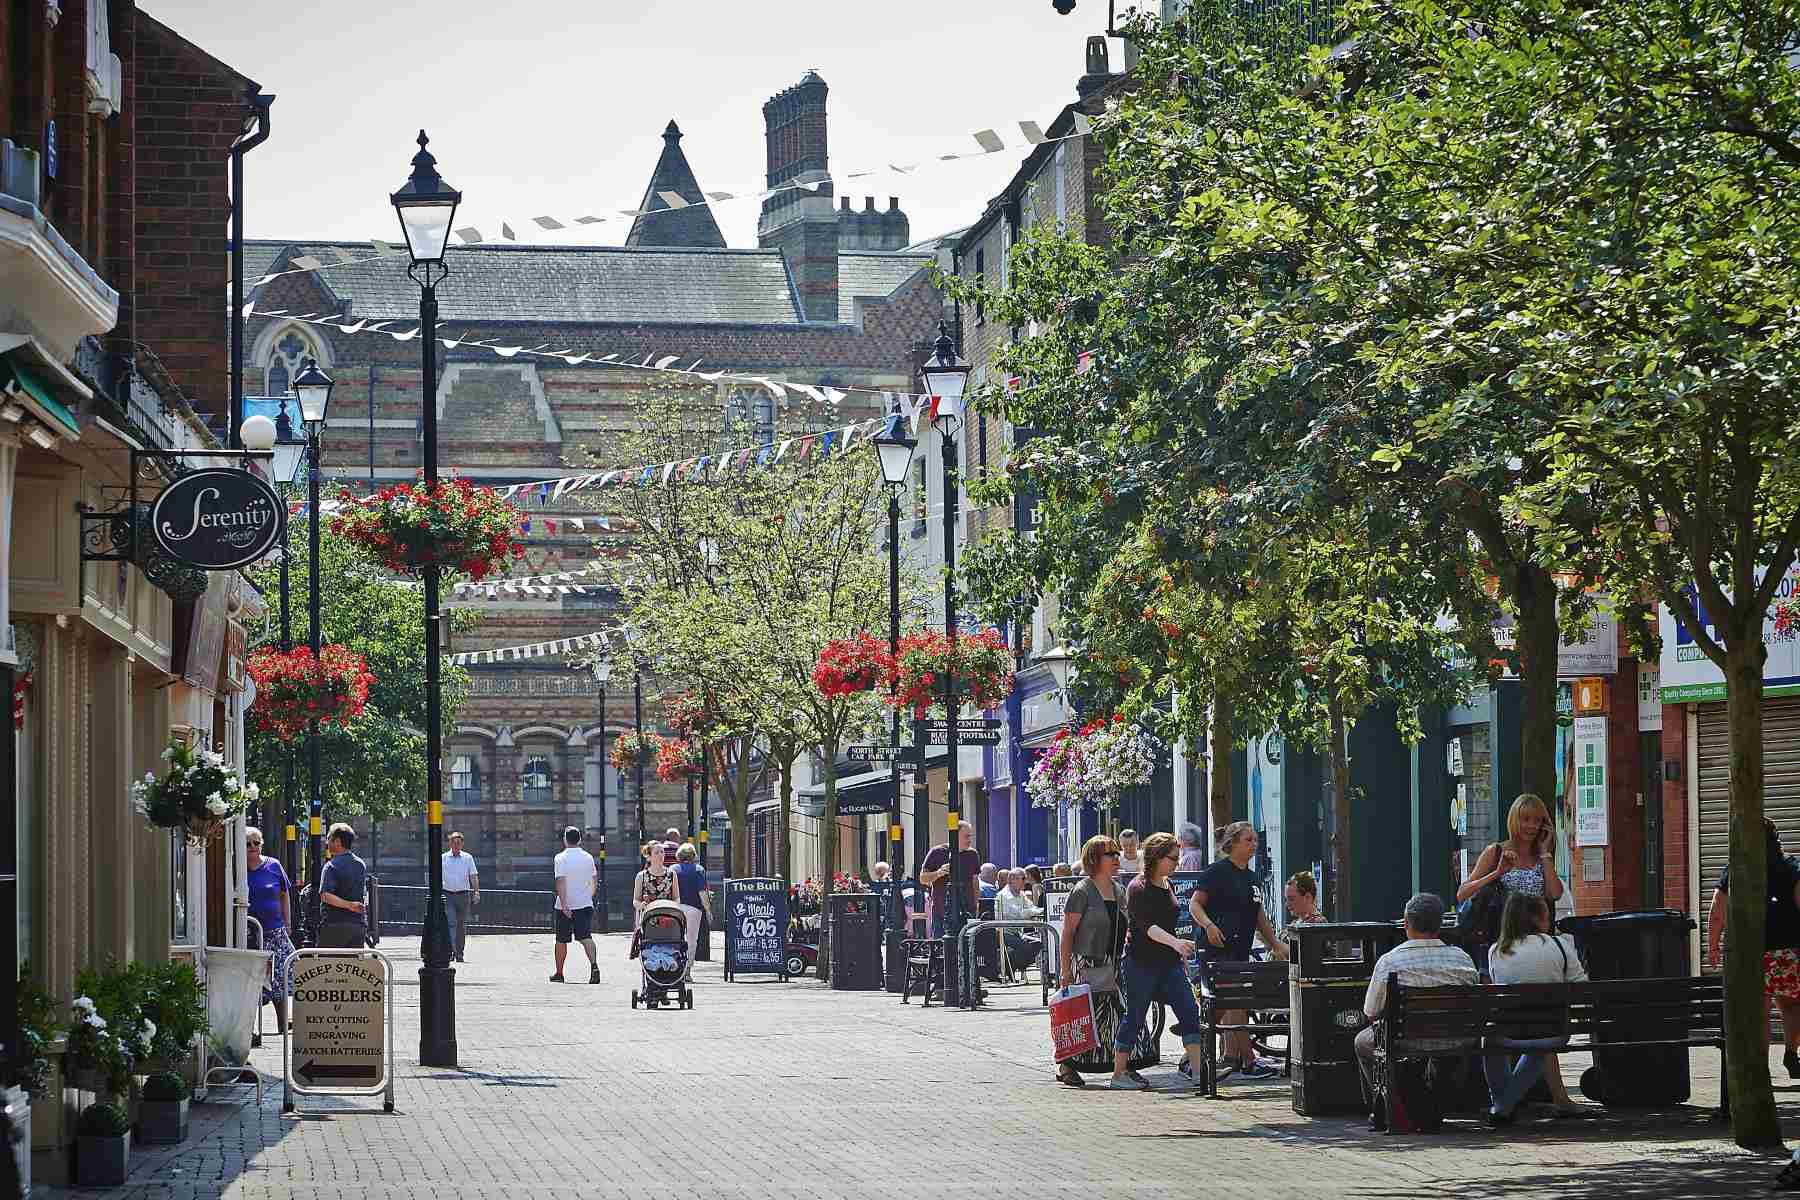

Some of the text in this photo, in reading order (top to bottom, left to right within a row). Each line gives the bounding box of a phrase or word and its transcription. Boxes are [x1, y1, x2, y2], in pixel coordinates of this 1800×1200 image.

[162, 487, 271, 540] Serenity
[957, 720, 986, 728] CENTRE
[959, 731, 997, 739] FOOTBALL
[733, 881, 780, 891] The Bull
[736, 902, 775, 917] 2 Meals
[294, 963, 384, 988] SHEEP STREET
[294, 989, 382, 1002] COBBLERS
[305, 1015, 370, 1024] KEY CUTTING
[308, 1031, 367, 1040] ENGRAVING
[293, 1047, 384, 1056] WATCH BATTERIES
